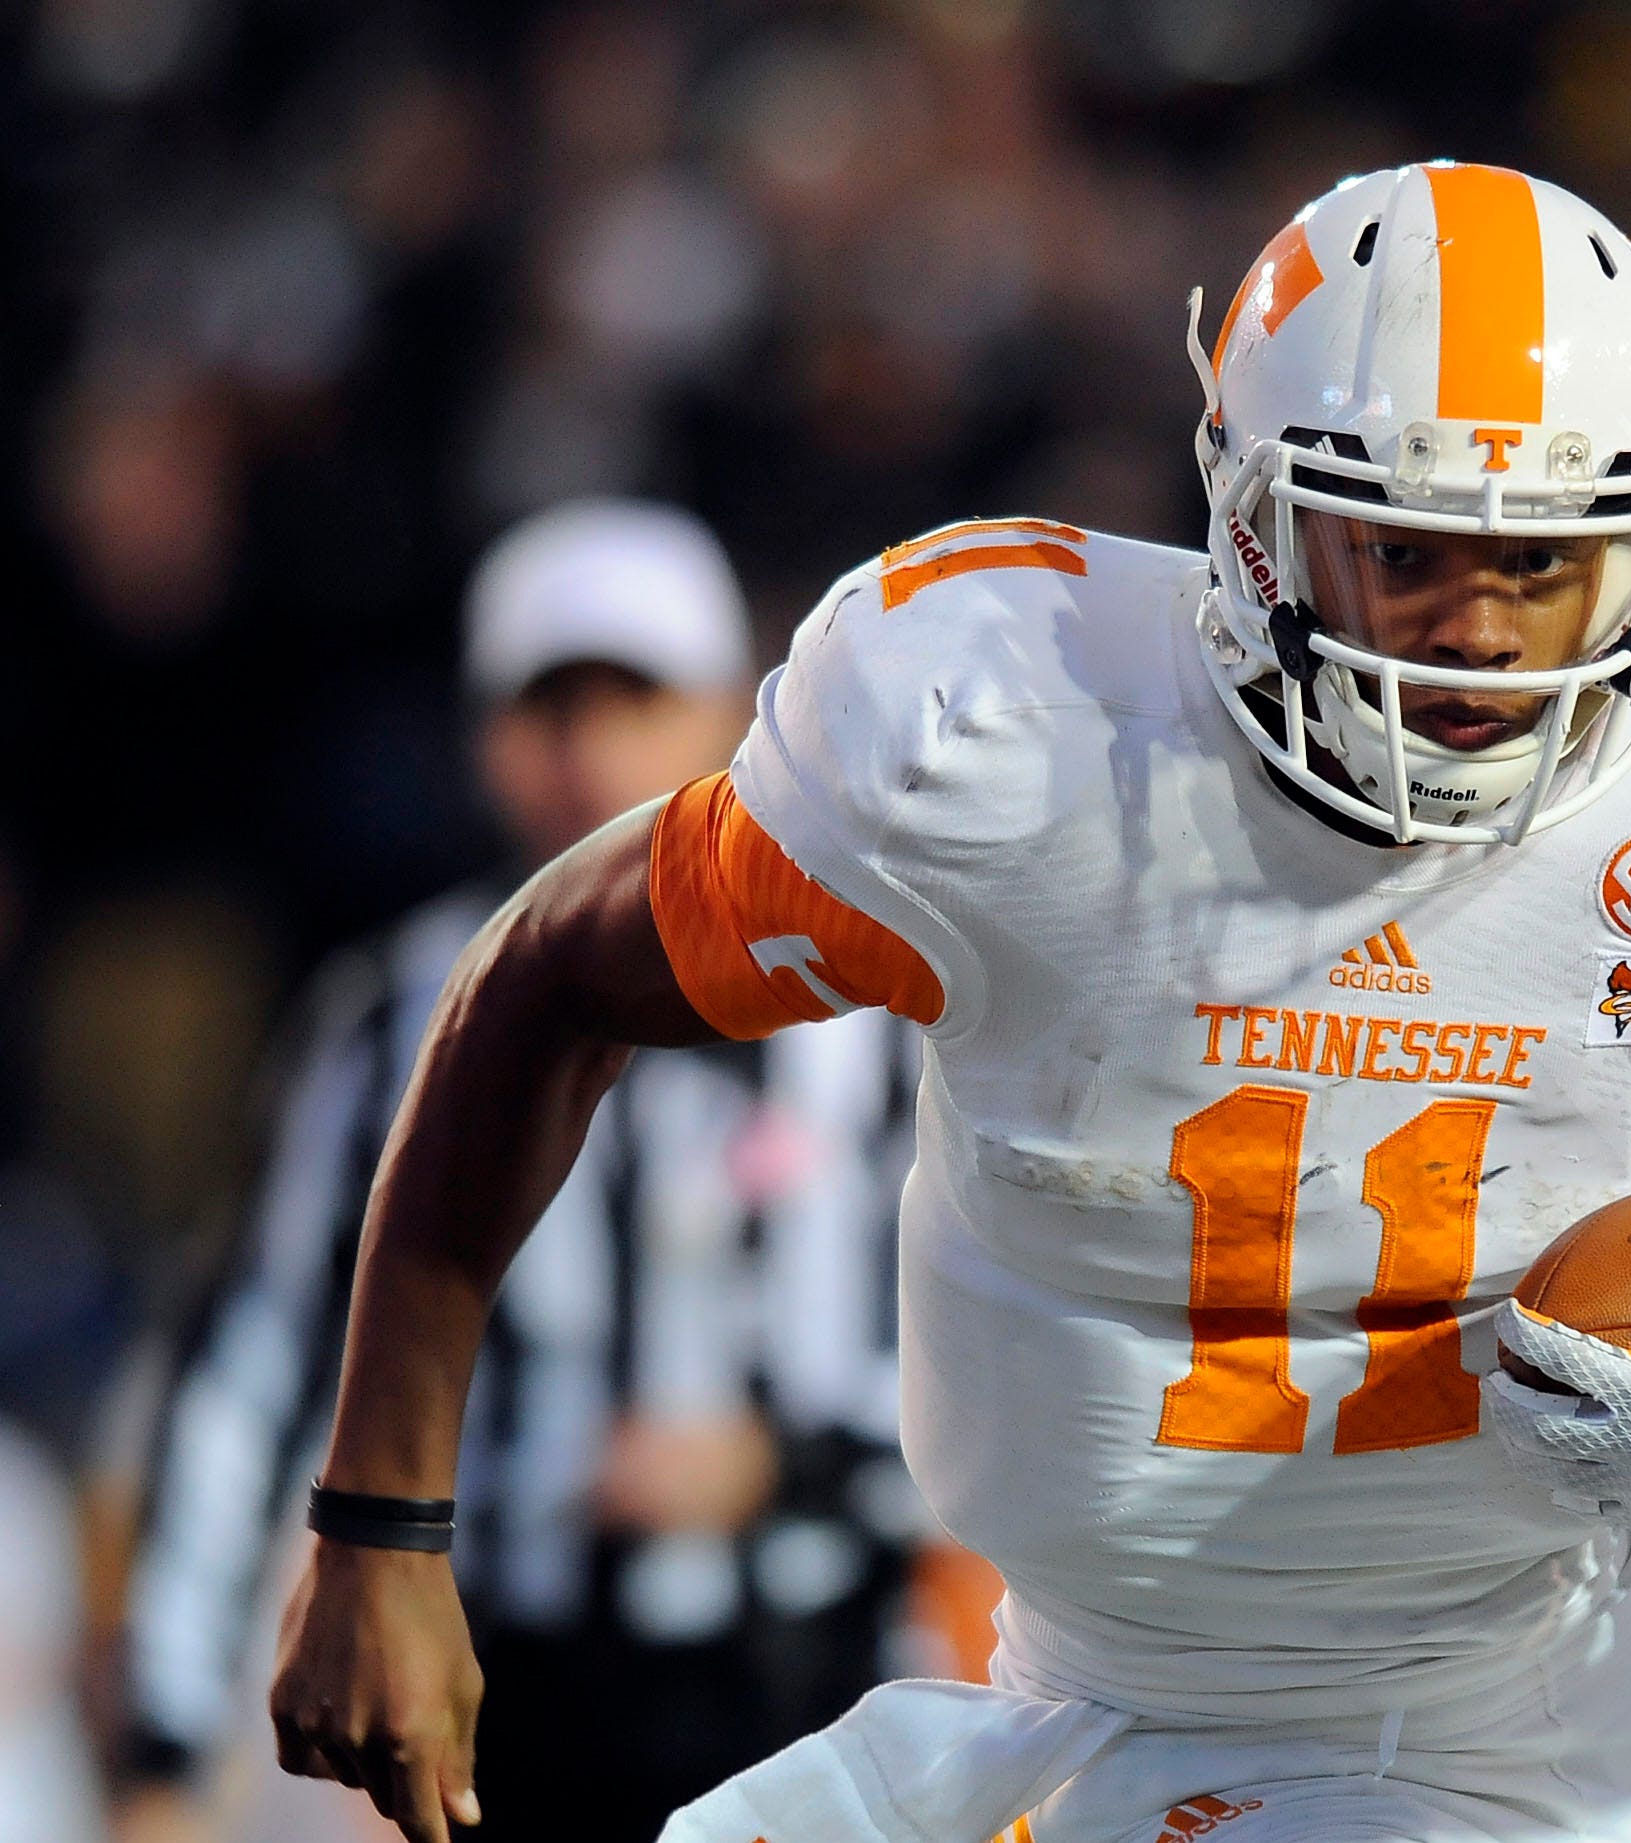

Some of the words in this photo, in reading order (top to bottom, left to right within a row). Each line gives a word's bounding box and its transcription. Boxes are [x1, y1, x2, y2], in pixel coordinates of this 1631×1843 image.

[1474, 428, 1523, 472] T
[1229, 508, 1280, 604] iddell
[1409, 780, 1479, 802] Riddell
[1328, 963, 1433, 996] adidas
[1194, 1001, 1549, 1090] TENNESSEE
[1153, 1082, 1500, 1457] 11
